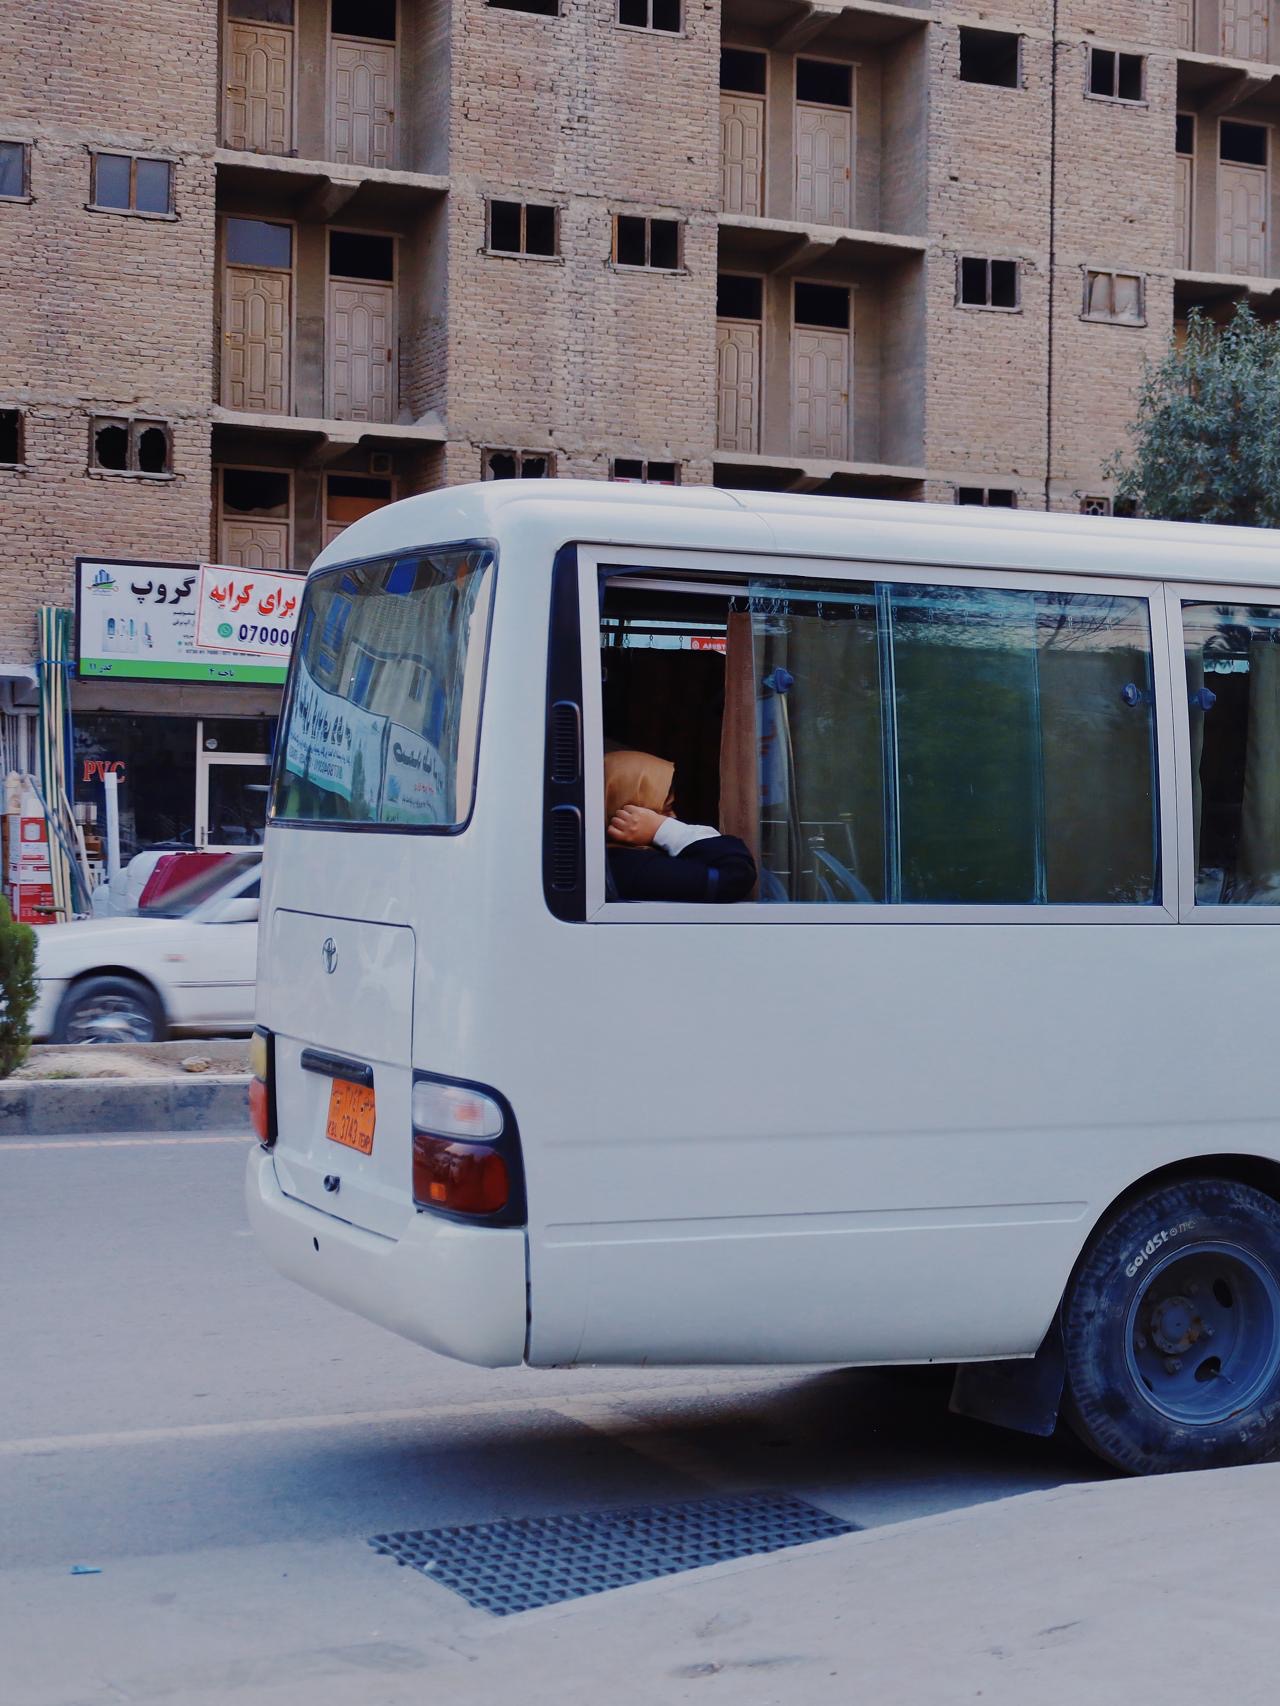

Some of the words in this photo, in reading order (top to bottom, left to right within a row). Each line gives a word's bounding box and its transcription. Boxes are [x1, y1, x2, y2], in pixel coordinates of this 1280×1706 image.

[209, 581, 254, 612] کرایه
[258, 587, 296, 618] برای
[83, 760, 126, 784] PVC
